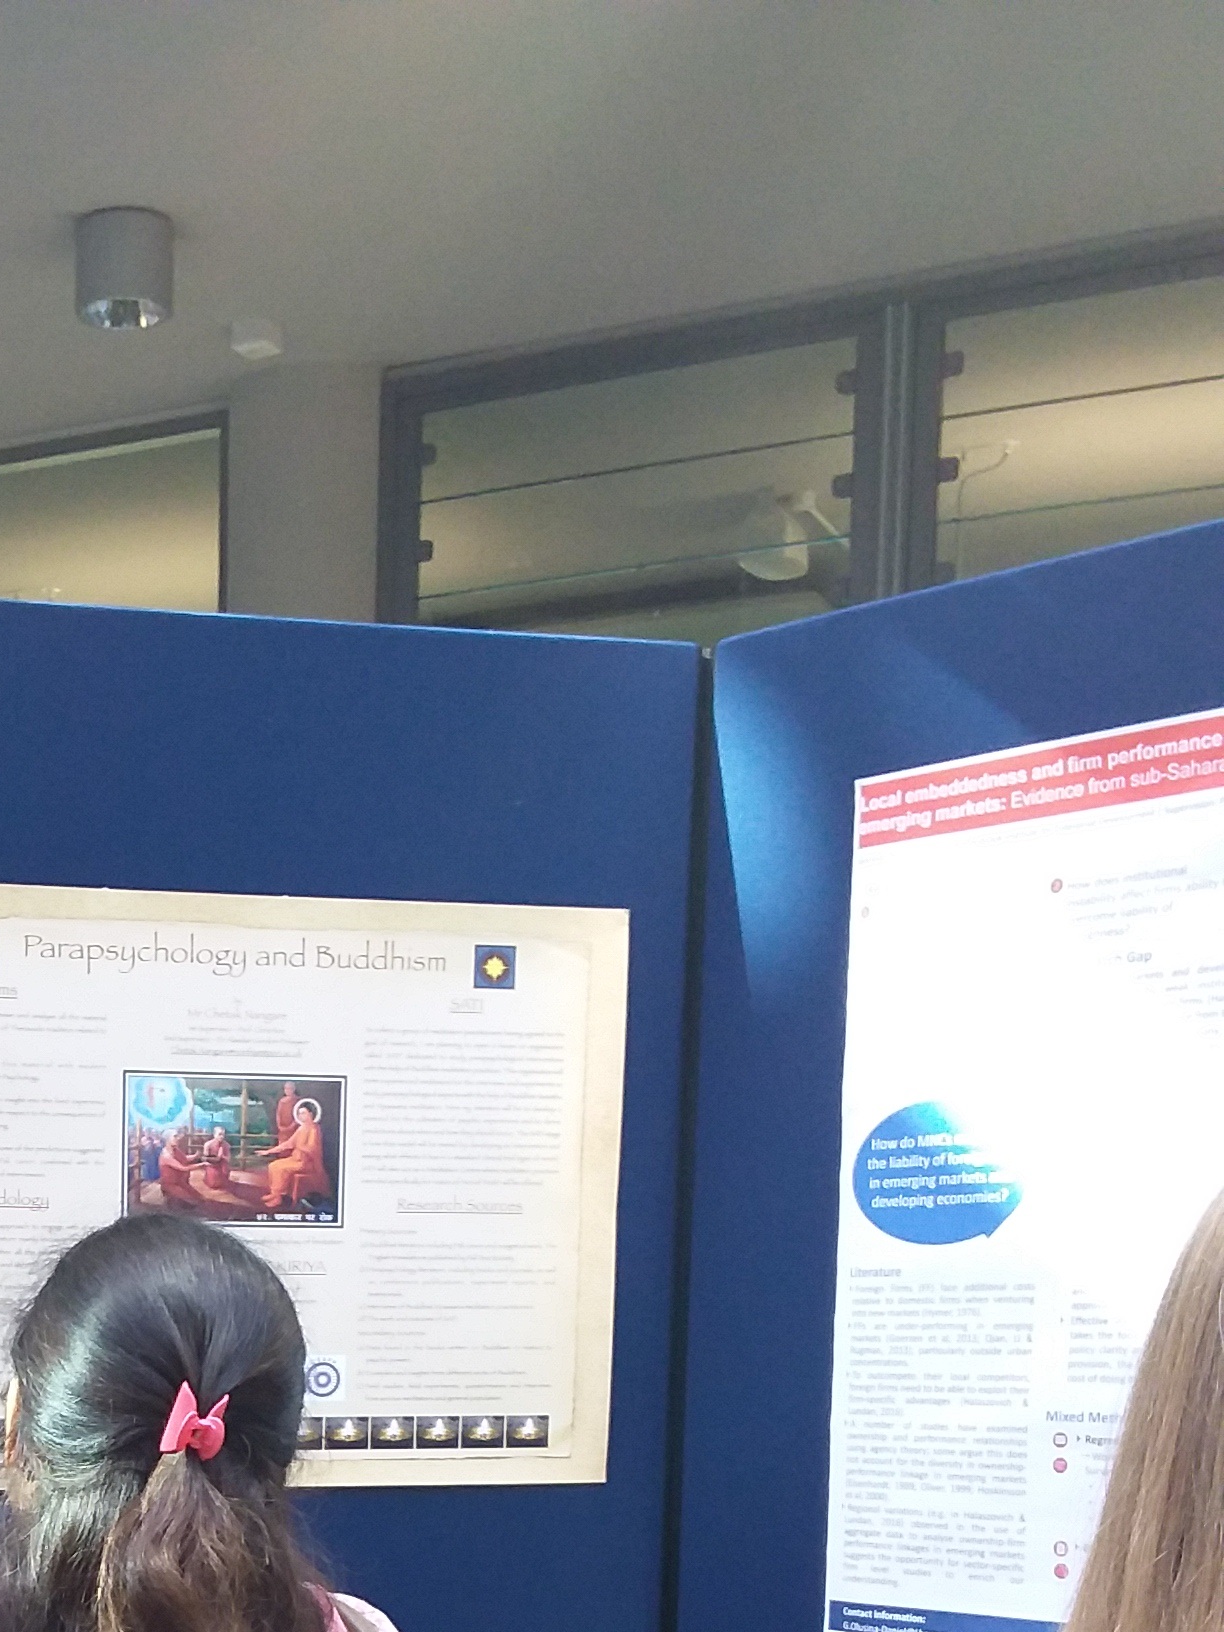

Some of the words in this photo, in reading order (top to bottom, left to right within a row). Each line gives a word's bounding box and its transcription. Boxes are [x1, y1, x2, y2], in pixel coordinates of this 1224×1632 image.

[860, 791, 902, 812] Local
[905, 769, 1027, 805] embeddedness
[1032, 761, 1064, 780] and
[1068, 754, 1102, 772] firm
[1108, 732, 1222, 769] performance
[860, 810, 932, 836] emerging
[936, 796, 1005, 821] markets:
[1011, 782, 1083, 809] Evidence
[1088, 776, 1125, 793] from
[24, 932, 246, 978] Parapsychology
[256, 938, 306, 968] and
[315, 940, 446, 973] Buddhism
[1127, 951, 1152, 965] Gap
[871, 1139, 897, 1150] How
[900, 1137, 915, 1147] do
[867, 1158, 887, 1170] the
[889, 1155, 930, 1169] liability
[933, 1153, 947, 1166] of
[869, 1177, 882, 1189] in
[882, 1176, 936, 1189] emerging
[397, 1194, 462, 1210] Research
[467, 1199, 523, 1211] Sources
[871, 1195, 934, 1208] developing
[850, 1268, 901, 1277] Literature
[1046, 1411, 1084, 1422] Mixed
[843, 1607, 872, 1618] Contact
[874, 1610, 926, 1624] Information:
